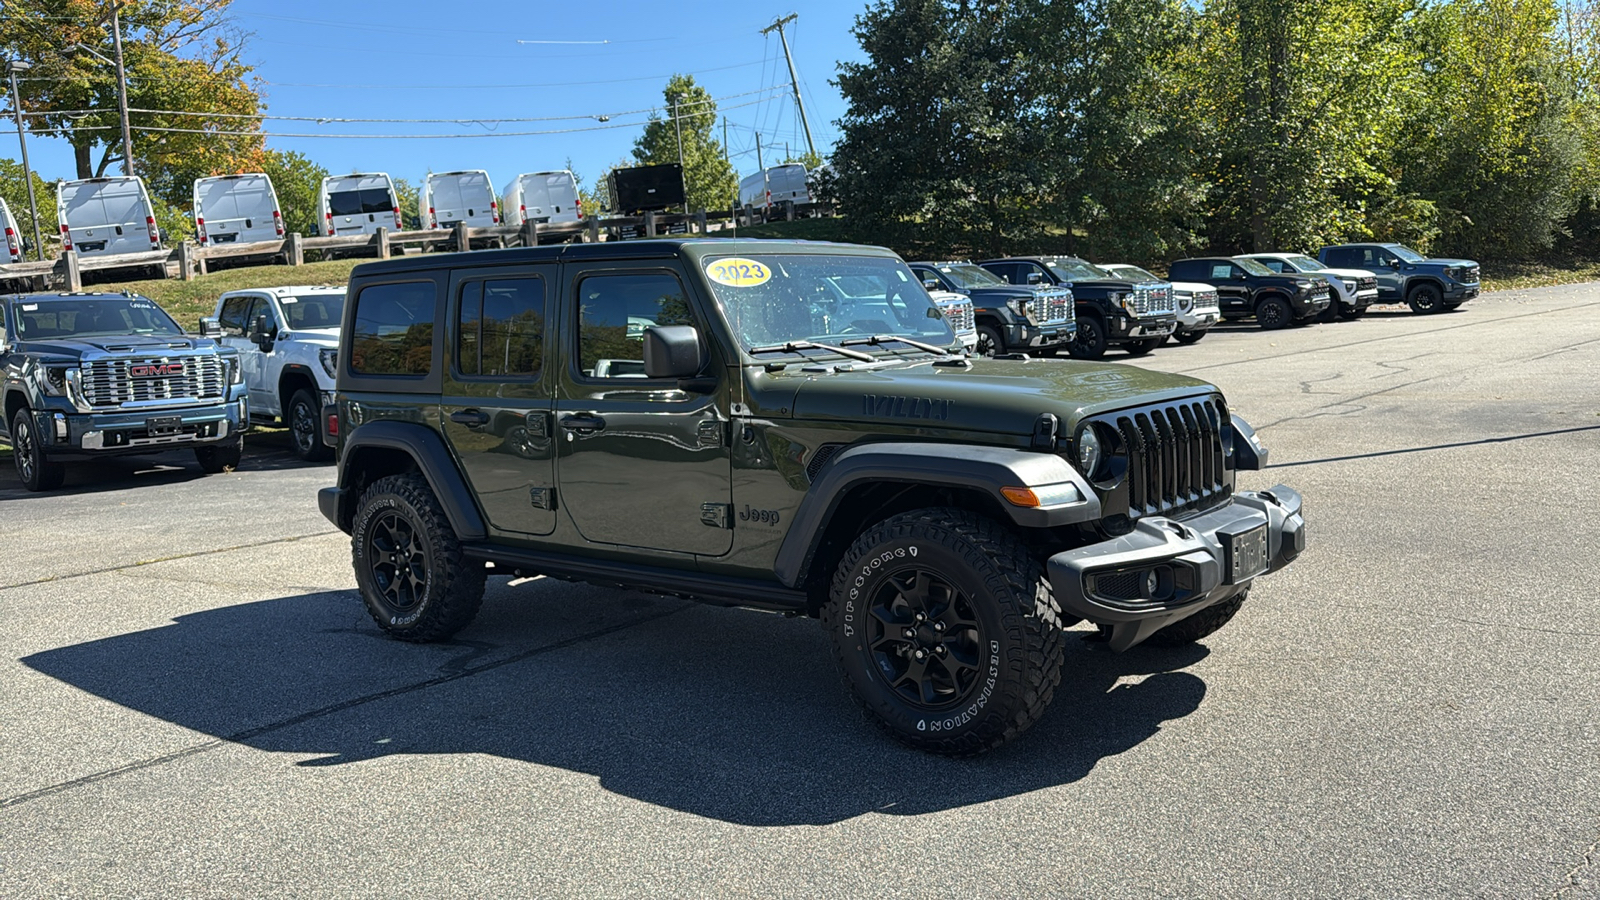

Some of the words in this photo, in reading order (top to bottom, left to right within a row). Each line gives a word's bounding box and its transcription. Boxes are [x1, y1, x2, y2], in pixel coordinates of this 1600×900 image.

[715, 264, 764, 280] 2023
[132, 364, 183, 376] GMC
[862, 394, 955, 421] WILLYS
[739, 505, 780, 526] Jeep
[844, 547, 906, 637] Firestone
[930, 640, 999, 732] DESTINATION
